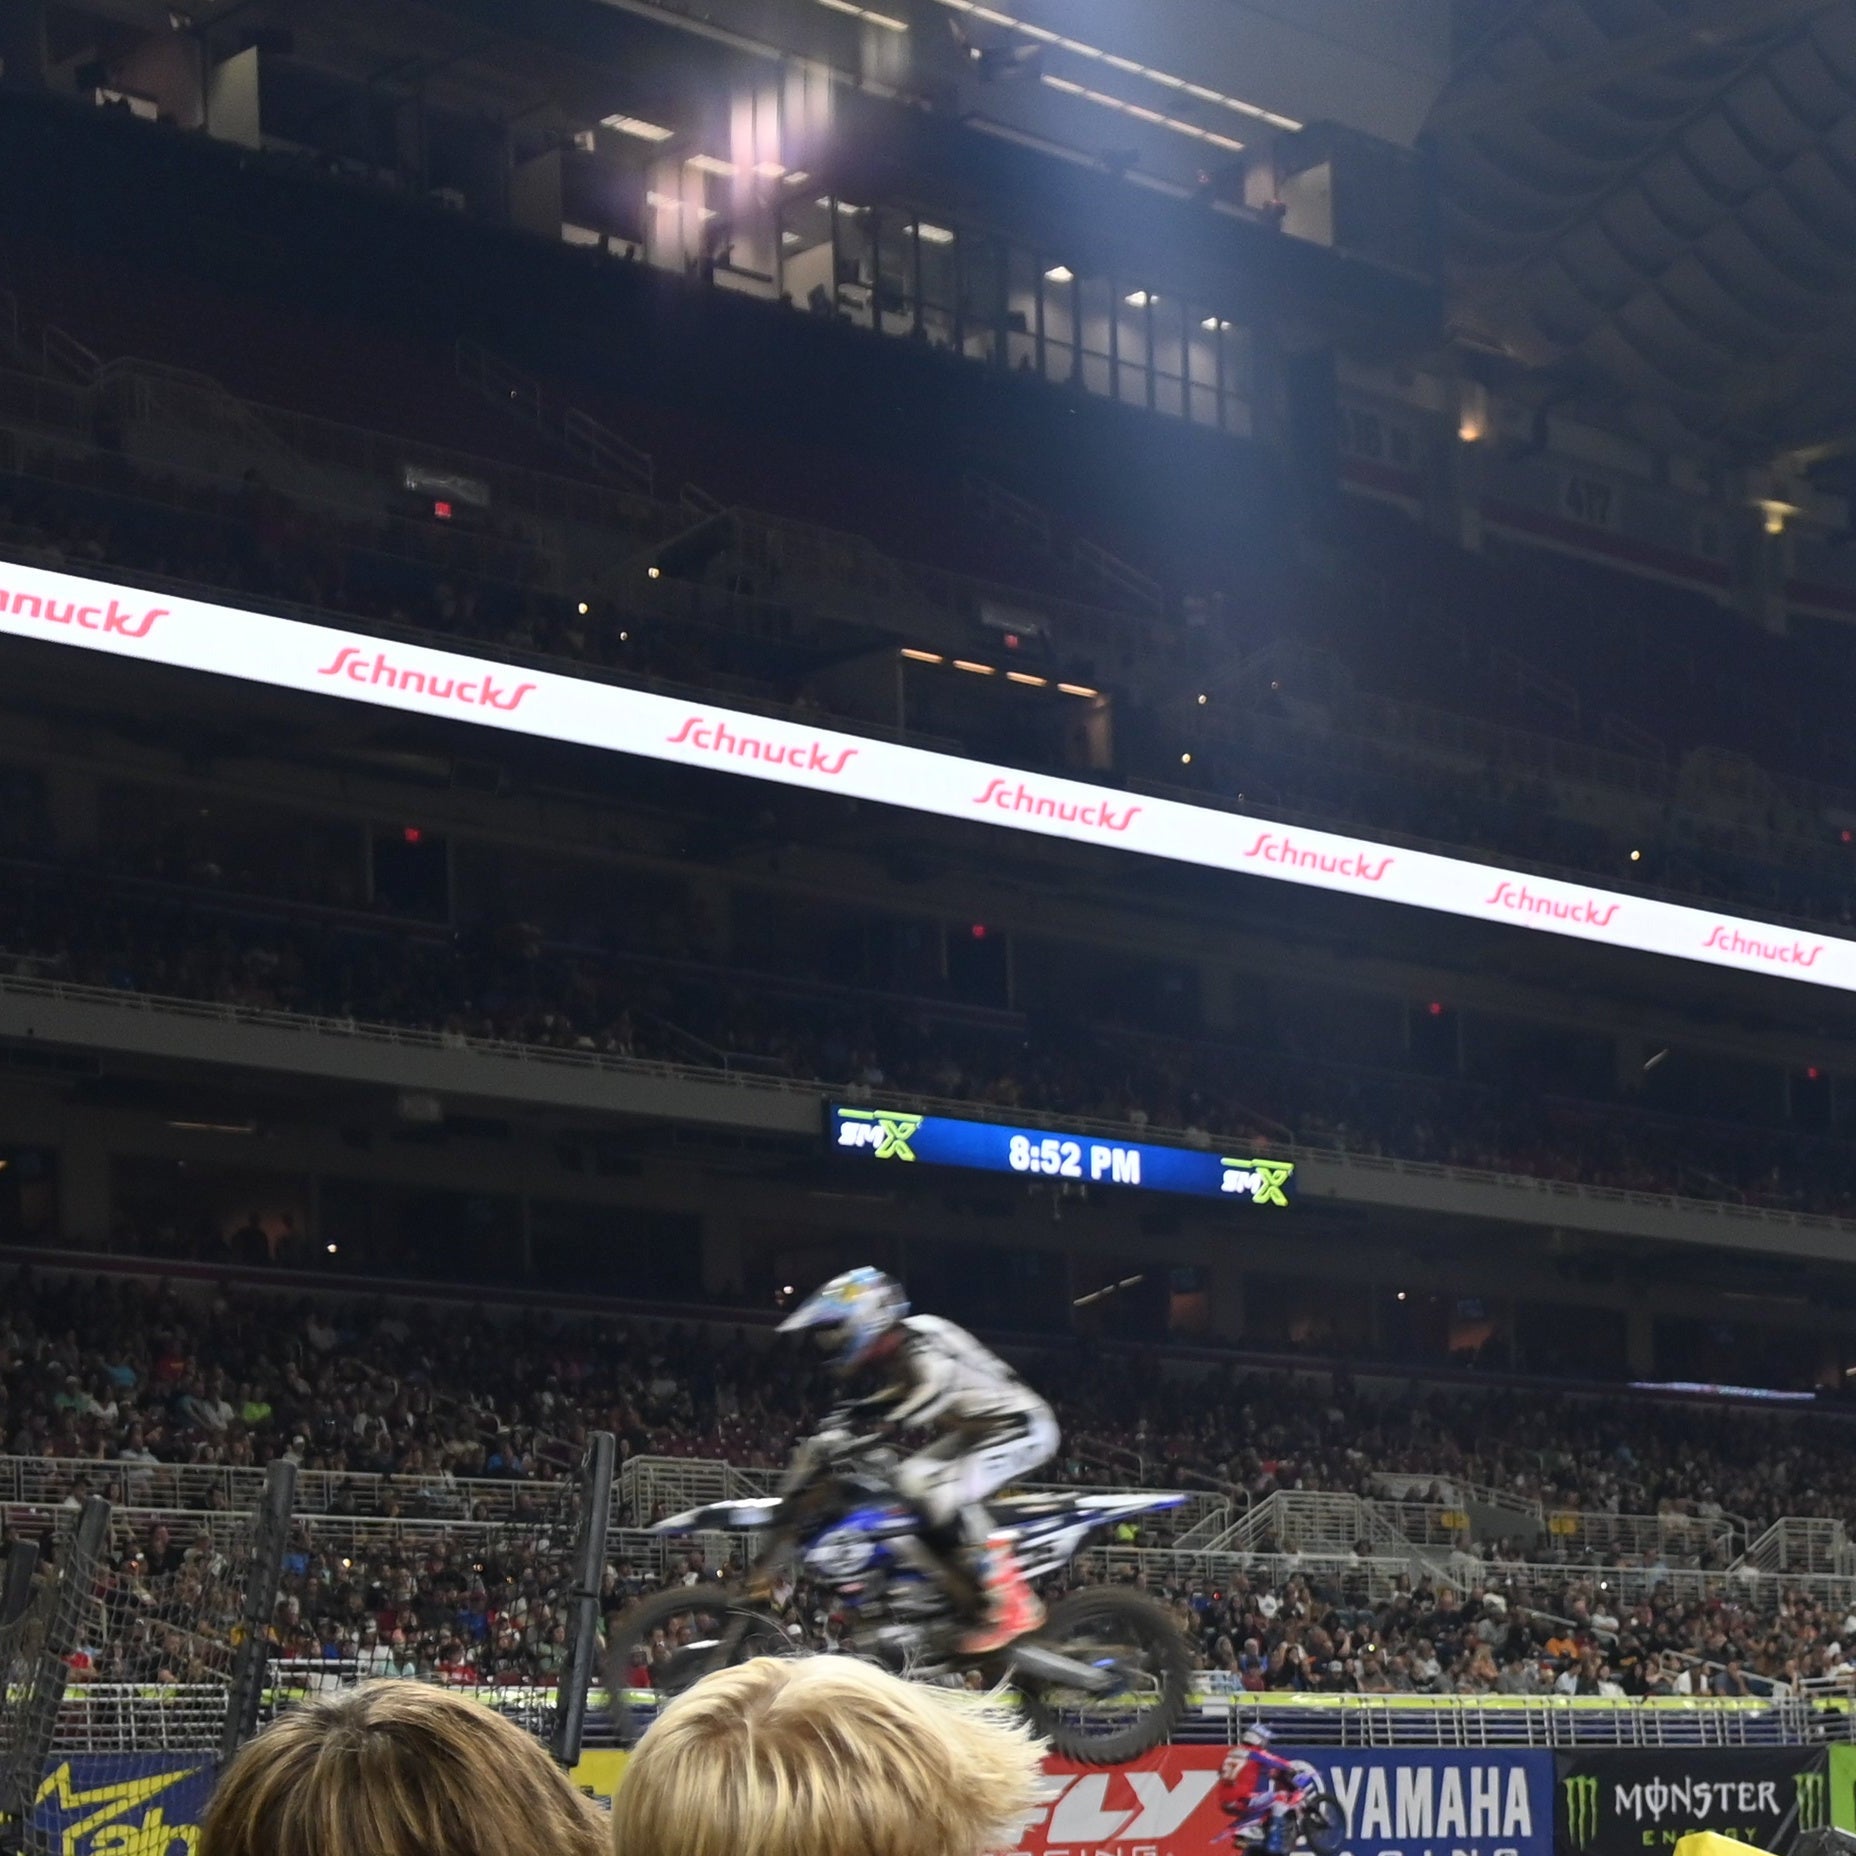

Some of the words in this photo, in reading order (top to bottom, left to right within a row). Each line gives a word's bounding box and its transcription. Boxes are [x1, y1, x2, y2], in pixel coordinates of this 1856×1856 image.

[1008, 1135, 1082, 1178] 8:52
[1090, 1144, 1141, 1186] PM
[1330, 1766, 1533, 1840] YAMAHA
[1615, 1776, 1781, 1823] MONSTER
[1642, 1827, 1758, 1847] ENEY
